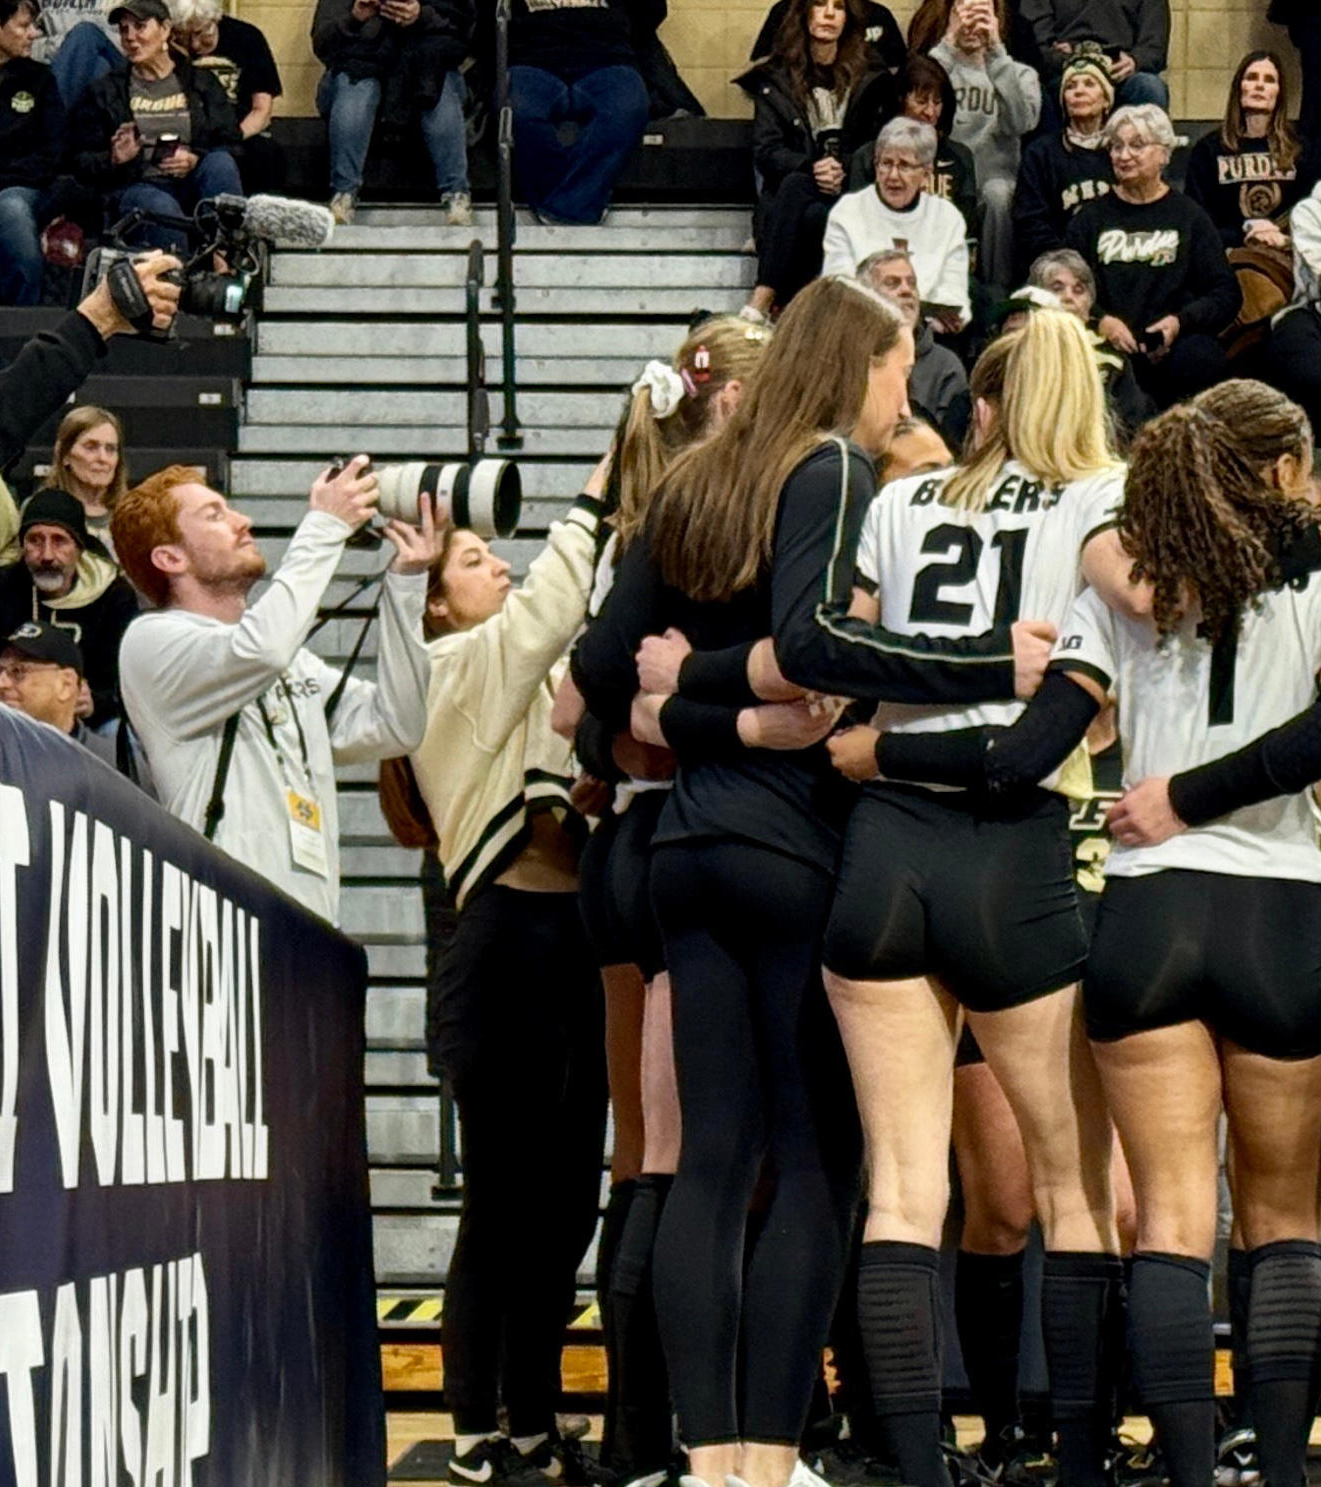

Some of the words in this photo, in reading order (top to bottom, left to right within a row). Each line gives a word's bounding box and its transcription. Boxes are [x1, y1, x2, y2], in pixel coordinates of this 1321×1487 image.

[1218, 153, 1295, 183] PURD
[907, 522, 1030, 628] 21
[45, 800, 270, 1190] VOLLEYBALL
